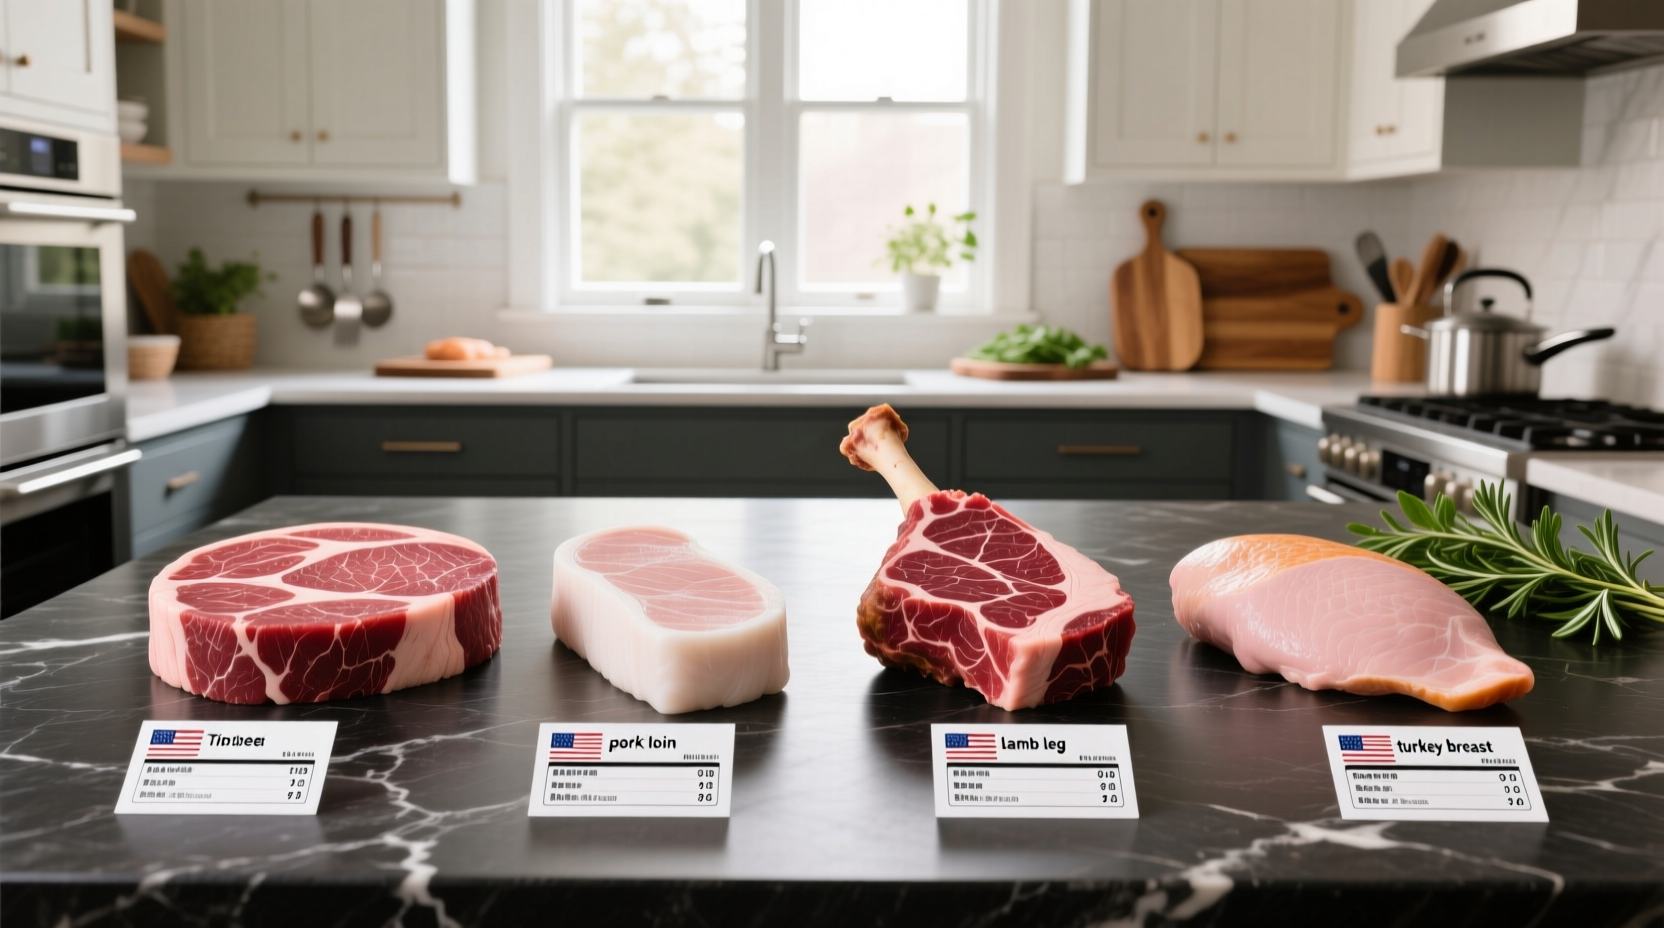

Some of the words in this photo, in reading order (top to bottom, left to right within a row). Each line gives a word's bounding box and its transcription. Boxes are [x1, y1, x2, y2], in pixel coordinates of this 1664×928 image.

[608, 734, 645, 753] pork
[648, 735, 677, 749] loin
[1001, 736, 1039, 750] lamb
[1043, 736, 1066, 755] leg
[1397, 738, 1442, 756] turkey
[1445, 738, 1493, 753] breast
